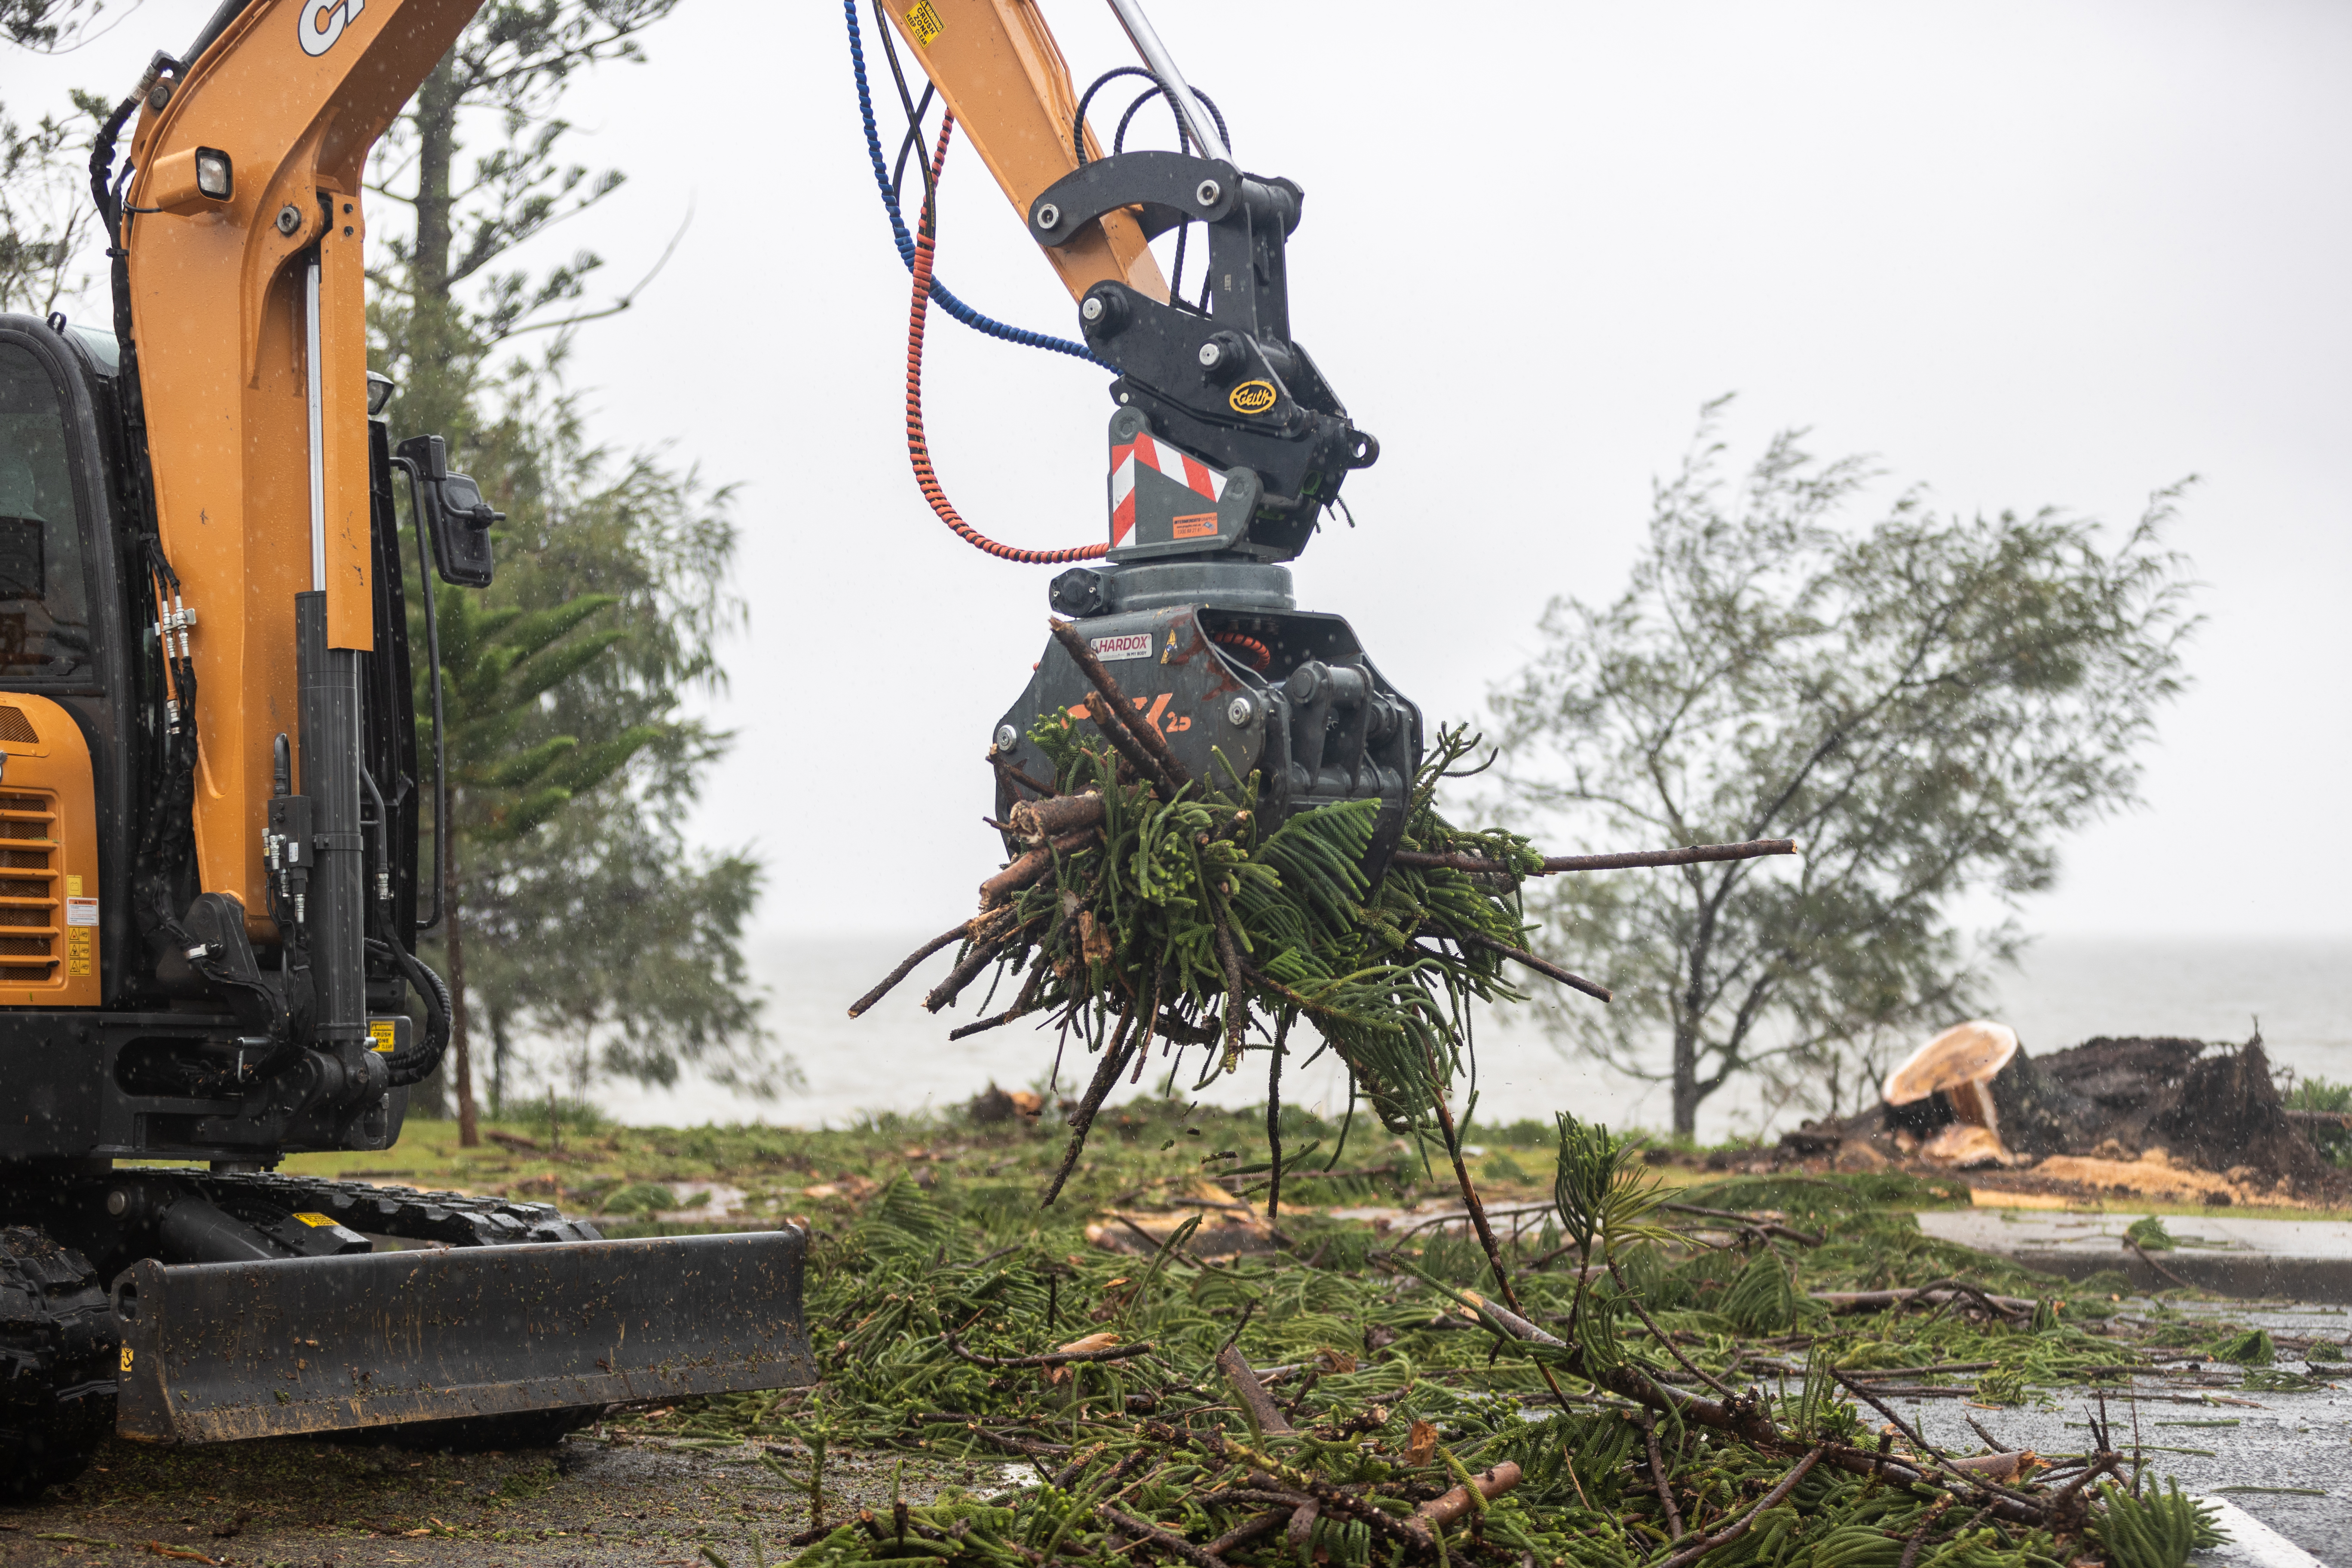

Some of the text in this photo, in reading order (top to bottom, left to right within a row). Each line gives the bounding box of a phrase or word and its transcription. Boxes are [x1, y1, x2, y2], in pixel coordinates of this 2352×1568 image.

[906, 14, 927, 46] KEEP CLEAR
[914, 14, 929, 37] ZONE
[917, 7, 935, 34] CRUSH
[925, 4, 942, 31] WARNING
[1099, 636, 1148, 652] HARDOX
